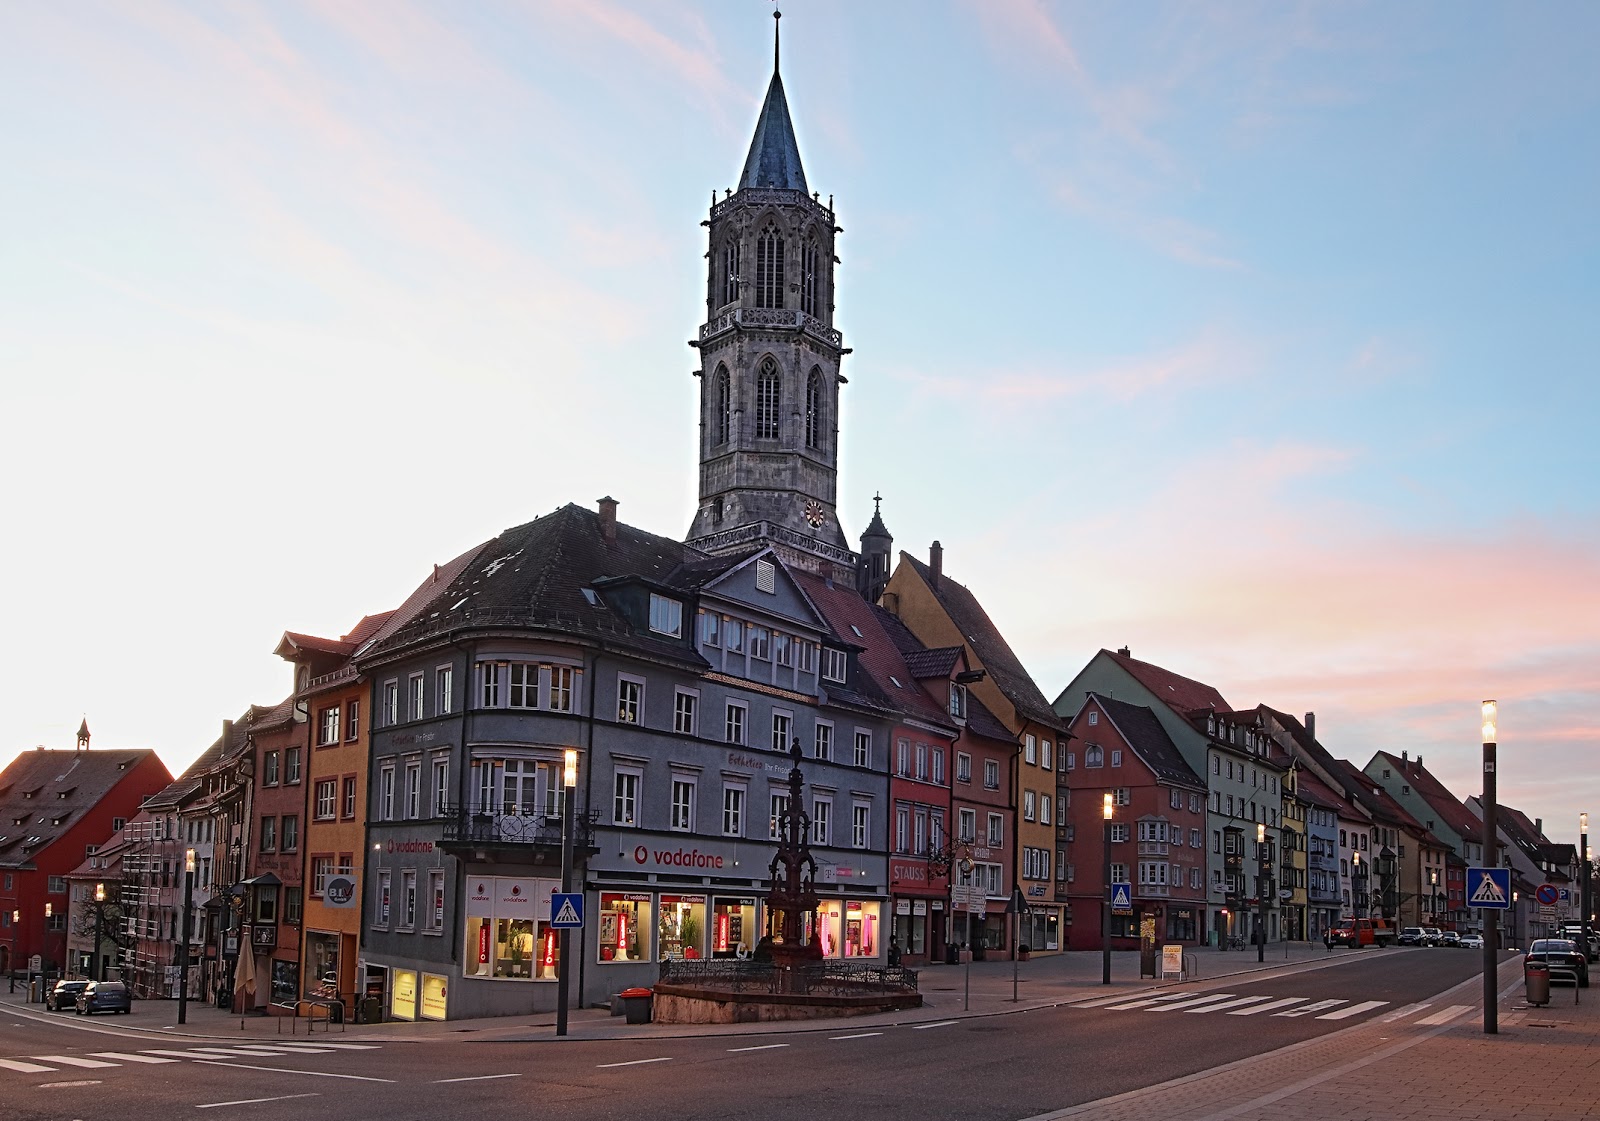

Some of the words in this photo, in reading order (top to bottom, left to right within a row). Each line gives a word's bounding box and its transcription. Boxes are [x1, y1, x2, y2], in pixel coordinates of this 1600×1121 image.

[395, 838, 433, 853] vodafone
[653, 848, 723, 868] vodafone
[894, 865, 924, 880] STAUSS
